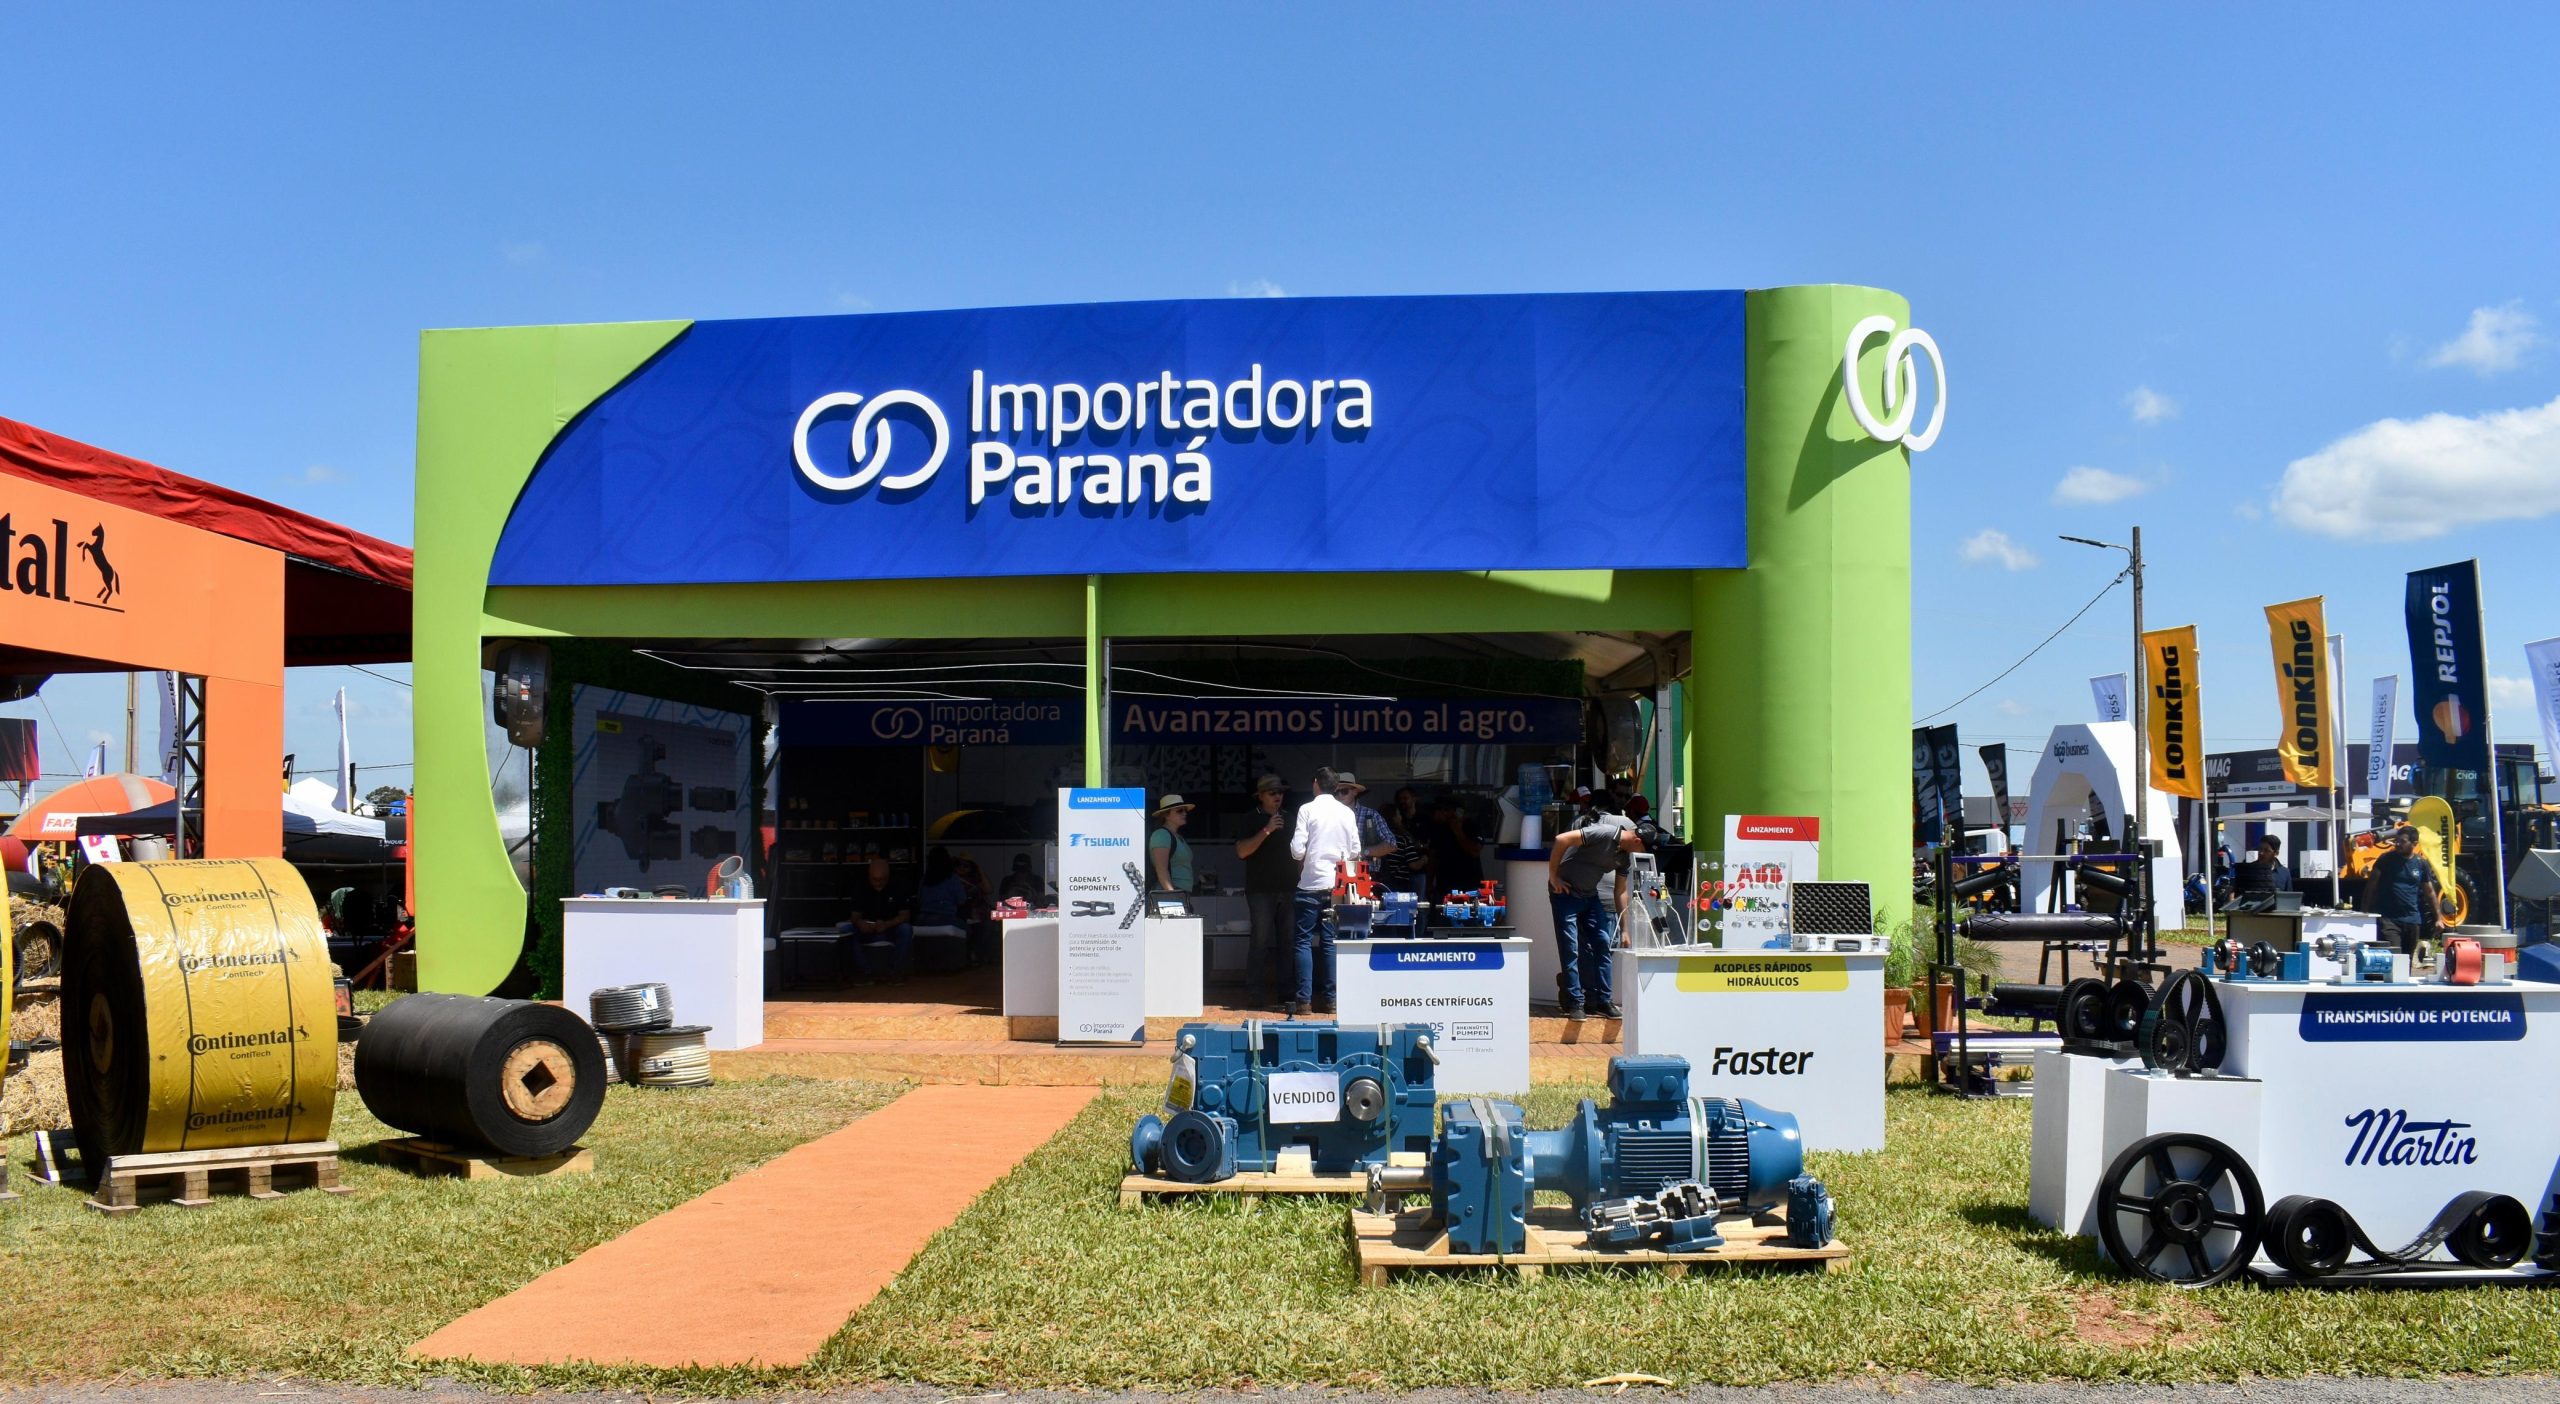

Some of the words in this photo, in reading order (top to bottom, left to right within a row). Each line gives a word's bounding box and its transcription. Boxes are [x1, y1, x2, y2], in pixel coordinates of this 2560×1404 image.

[972, 364, 1373, 447] Importadora
[971, 436, 1212, 505] Paraná
[2432, 582, 2457, 683] REPSOL
[930, 701, 1061, 726] Importadora
[2108, 694, 2121, 722] ness
[1123, 704, 1323, 732] Avanzamos
[1331, 703, 1413, 738] junto
[1422, 702, 1448, 732] al
[1459, 709, 1534, 738] agro.
[2372, 693, 2387, 752] business
[930, 724, 1010, 744] Paraná
[1746, 826, 1794, 834] LANZAMIENTO
[1083, 837, 1130, 847] TSUBAKI
[1737, 864, 1783, 883] ABB
[162, 889, 265, 907] Continental
[1397, 951, 1476, 963] LANZAMIENTO
[1713, 963, 1762, 973] ACOPLES
[1764, 960, 1813, 973] RÁPIDOS
[1727, 974, 1799, 987] HIDRÁULICOS
[1380, 997, 1423, 1007] BOMBAS
[1425, 995, 1494, 1007] CENTRÍFUGAS
[2316, 1007, 2415, 1024] TRANSMISIÓN
[2419, 1010, 2438, 1023] DE
[2441, 1010, 2512, 1023] POTENCIA
[187, 1026, 296, 1056] Continental
[230, 1049, 272, 1060] ContiTech
[1712, 1047, 1814, 1076] Faster
[1273, 1091, 1336, 1105] VENDIDO
[185, 1103, 293, 1131] Continental
[2344, 1108, 2478, 1167] Martin
